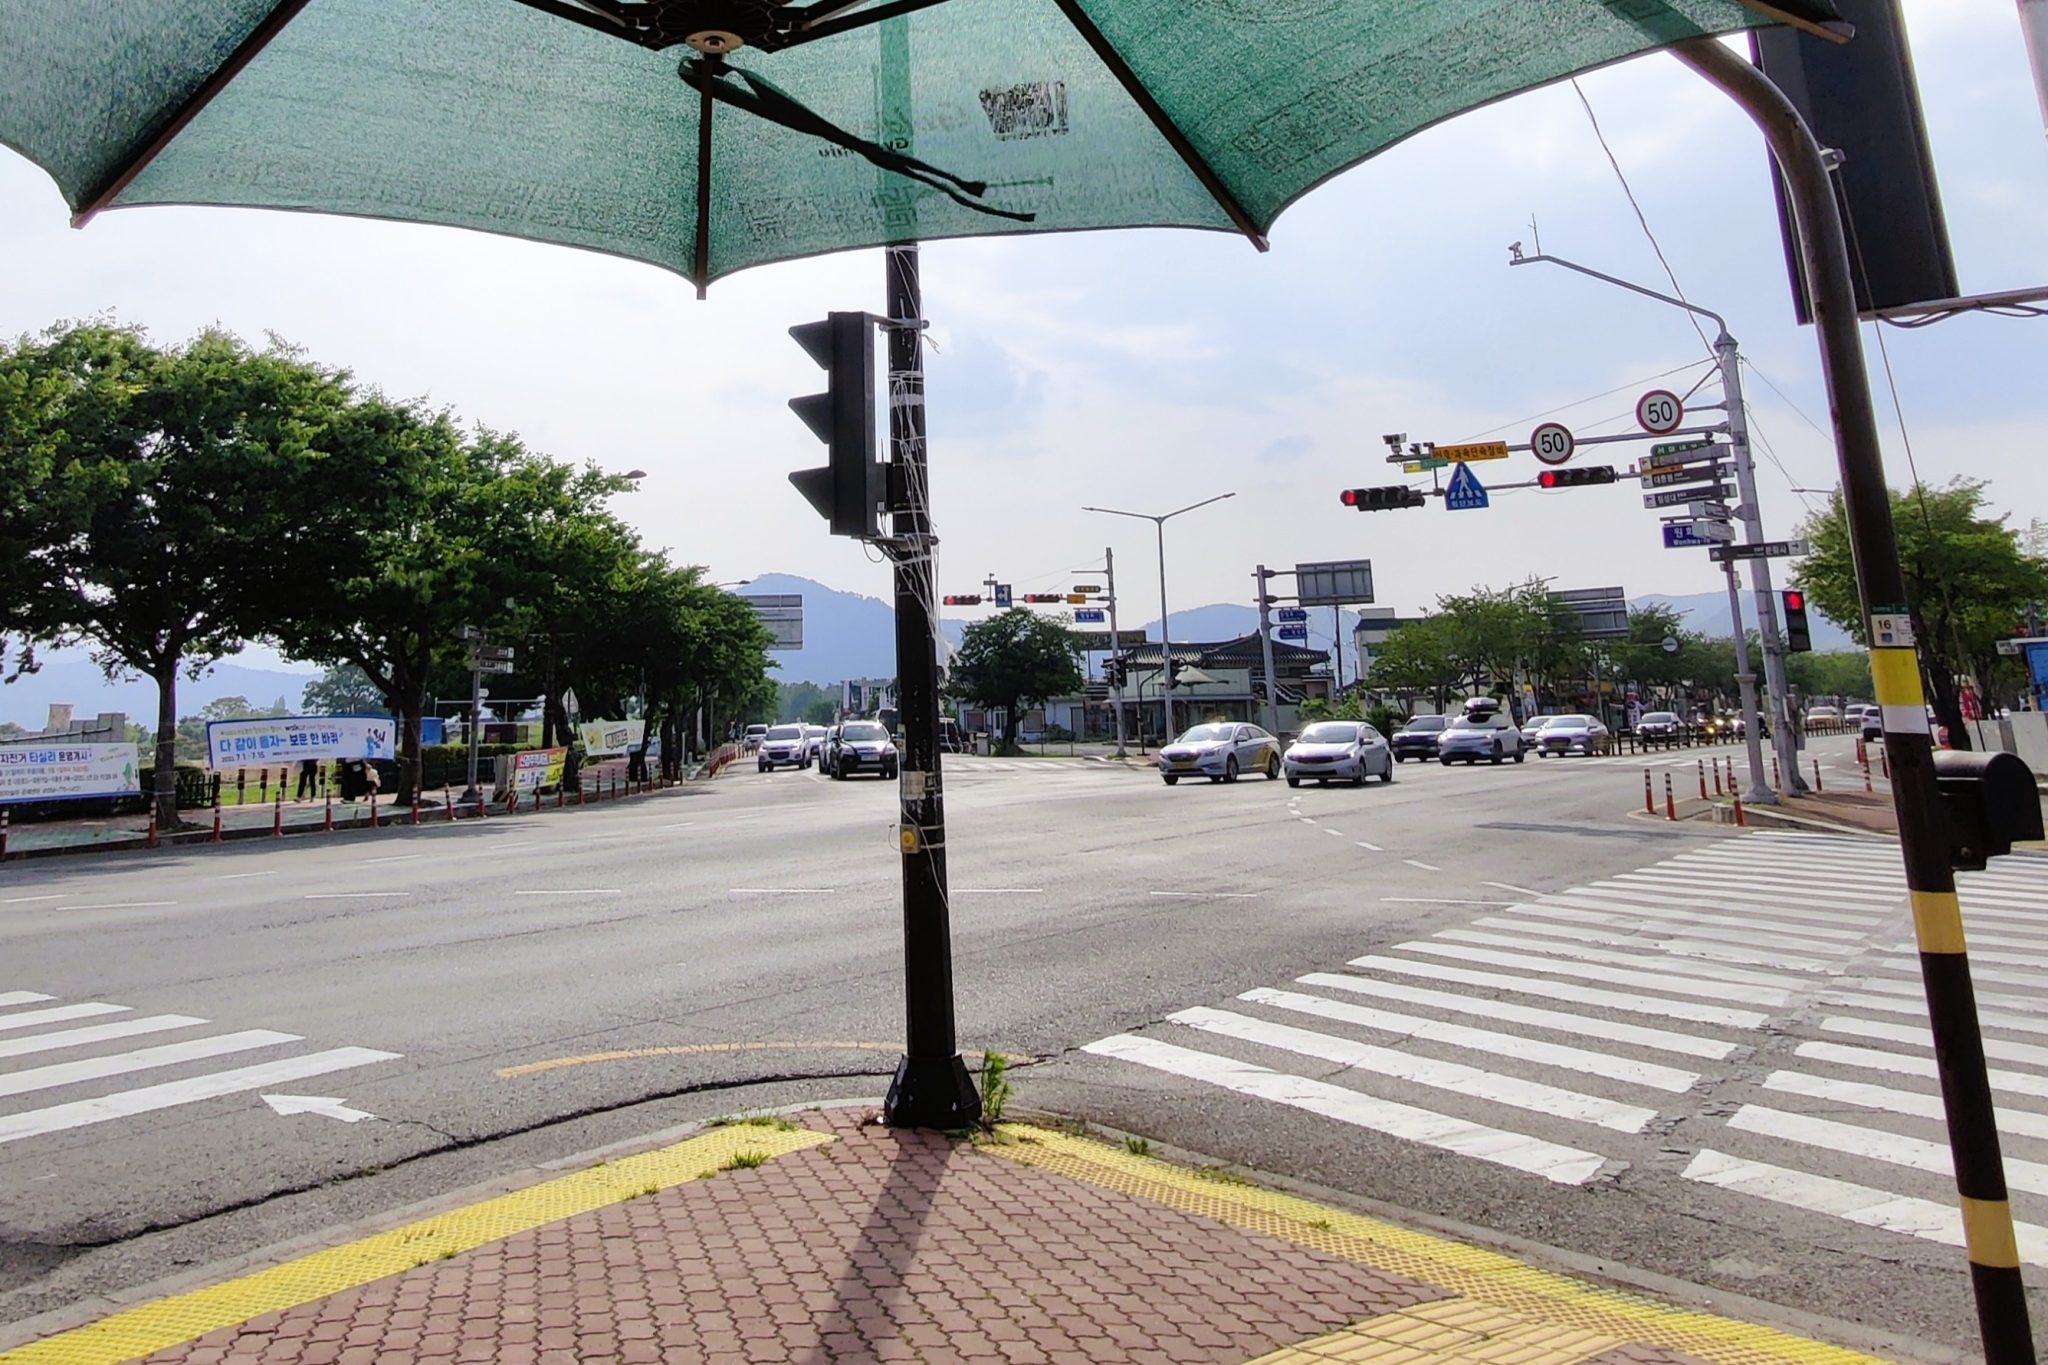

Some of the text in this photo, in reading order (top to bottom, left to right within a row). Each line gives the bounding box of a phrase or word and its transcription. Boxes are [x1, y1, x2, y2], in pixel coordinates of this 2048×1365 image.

[1647, 401, 1673, 424] 50
[1540, 432, 1566, 454] 50
[1878, 619, 1892, 630] 16
